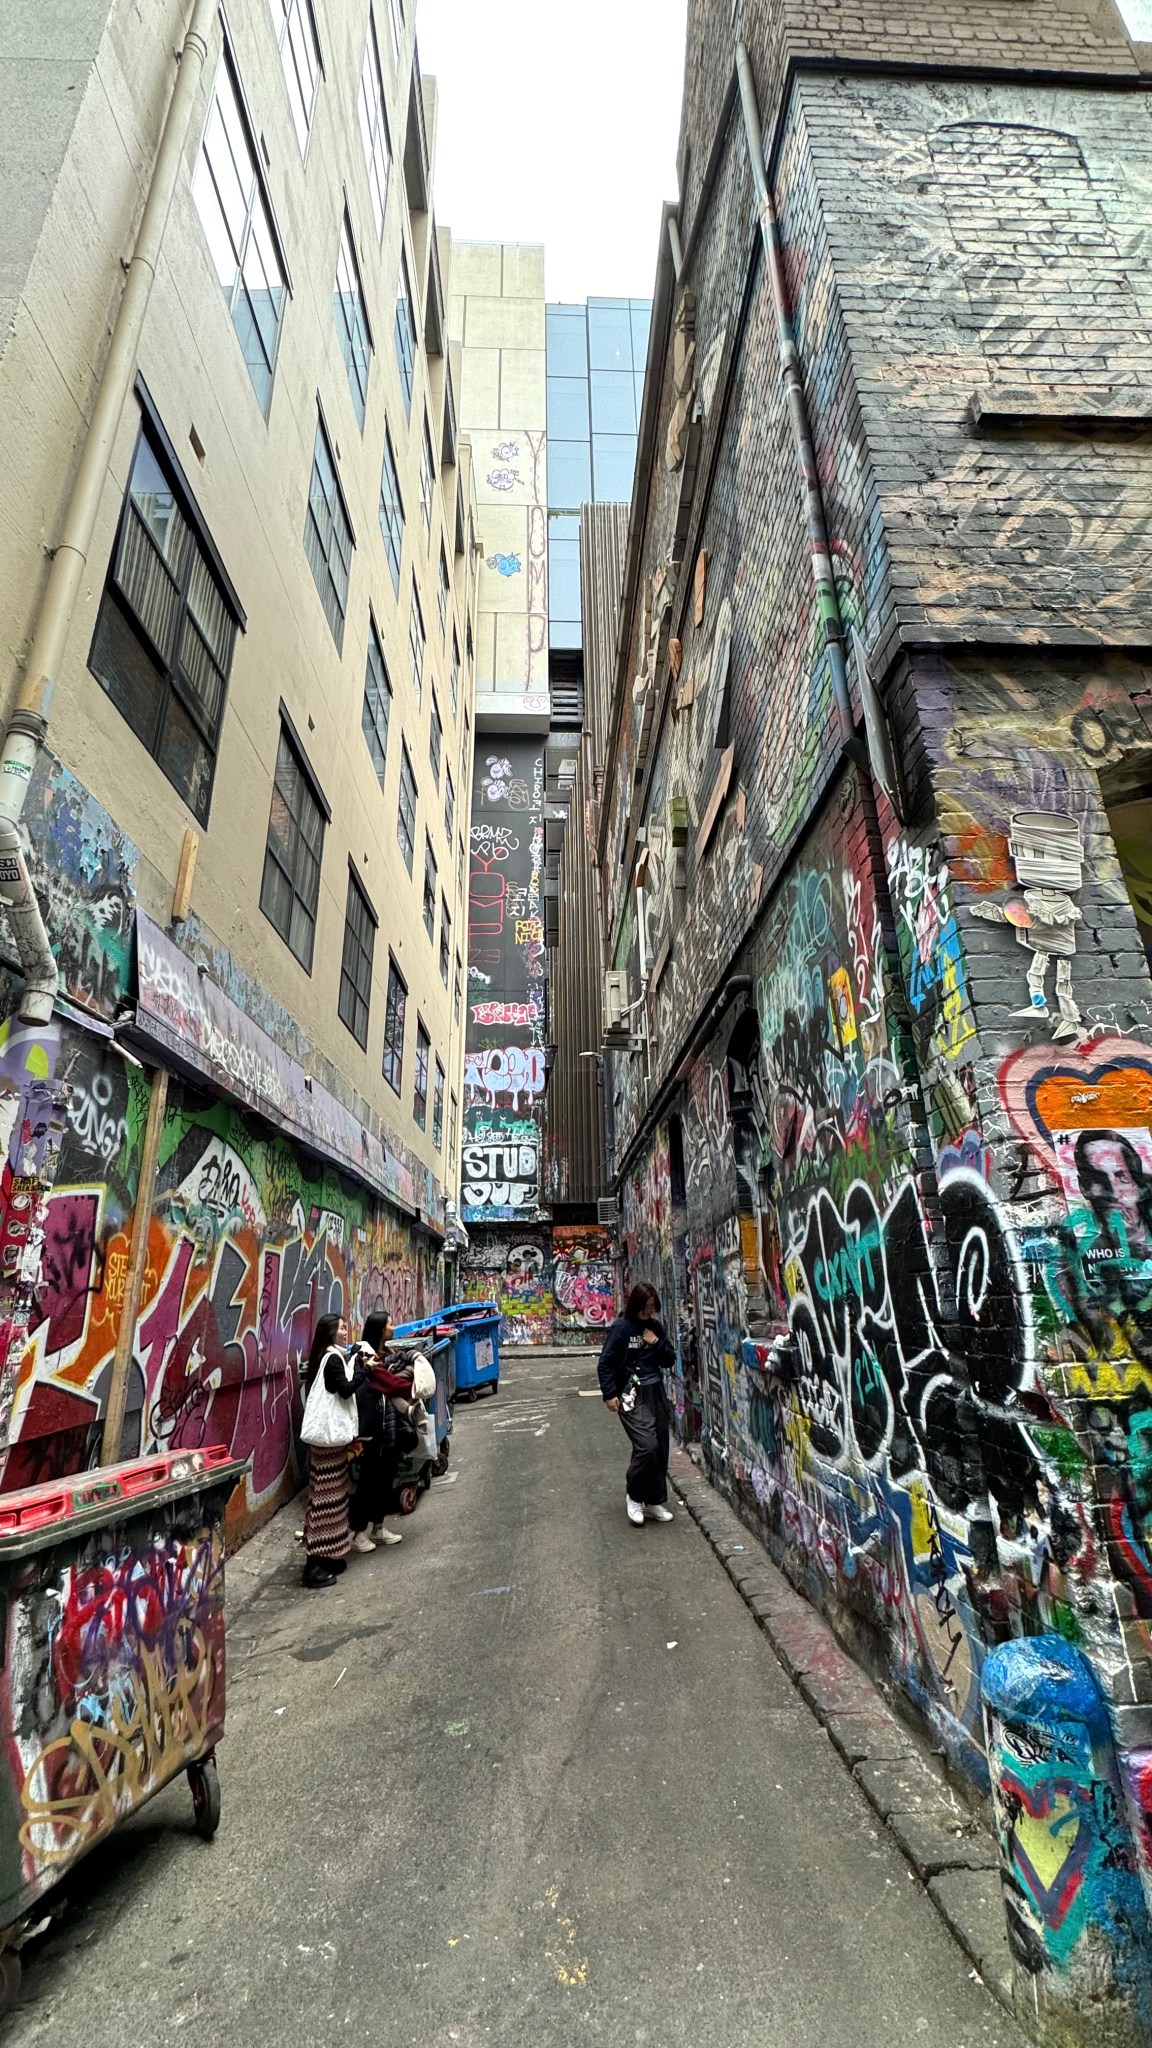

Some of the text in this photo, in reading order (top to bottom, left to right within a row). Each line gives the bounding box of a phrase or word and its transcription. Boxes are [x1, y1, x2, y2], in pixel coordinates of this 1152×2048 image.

[462, 1146, 536, 1179] STUD
[1086, 1248, 1125, 1259] WHO IS
